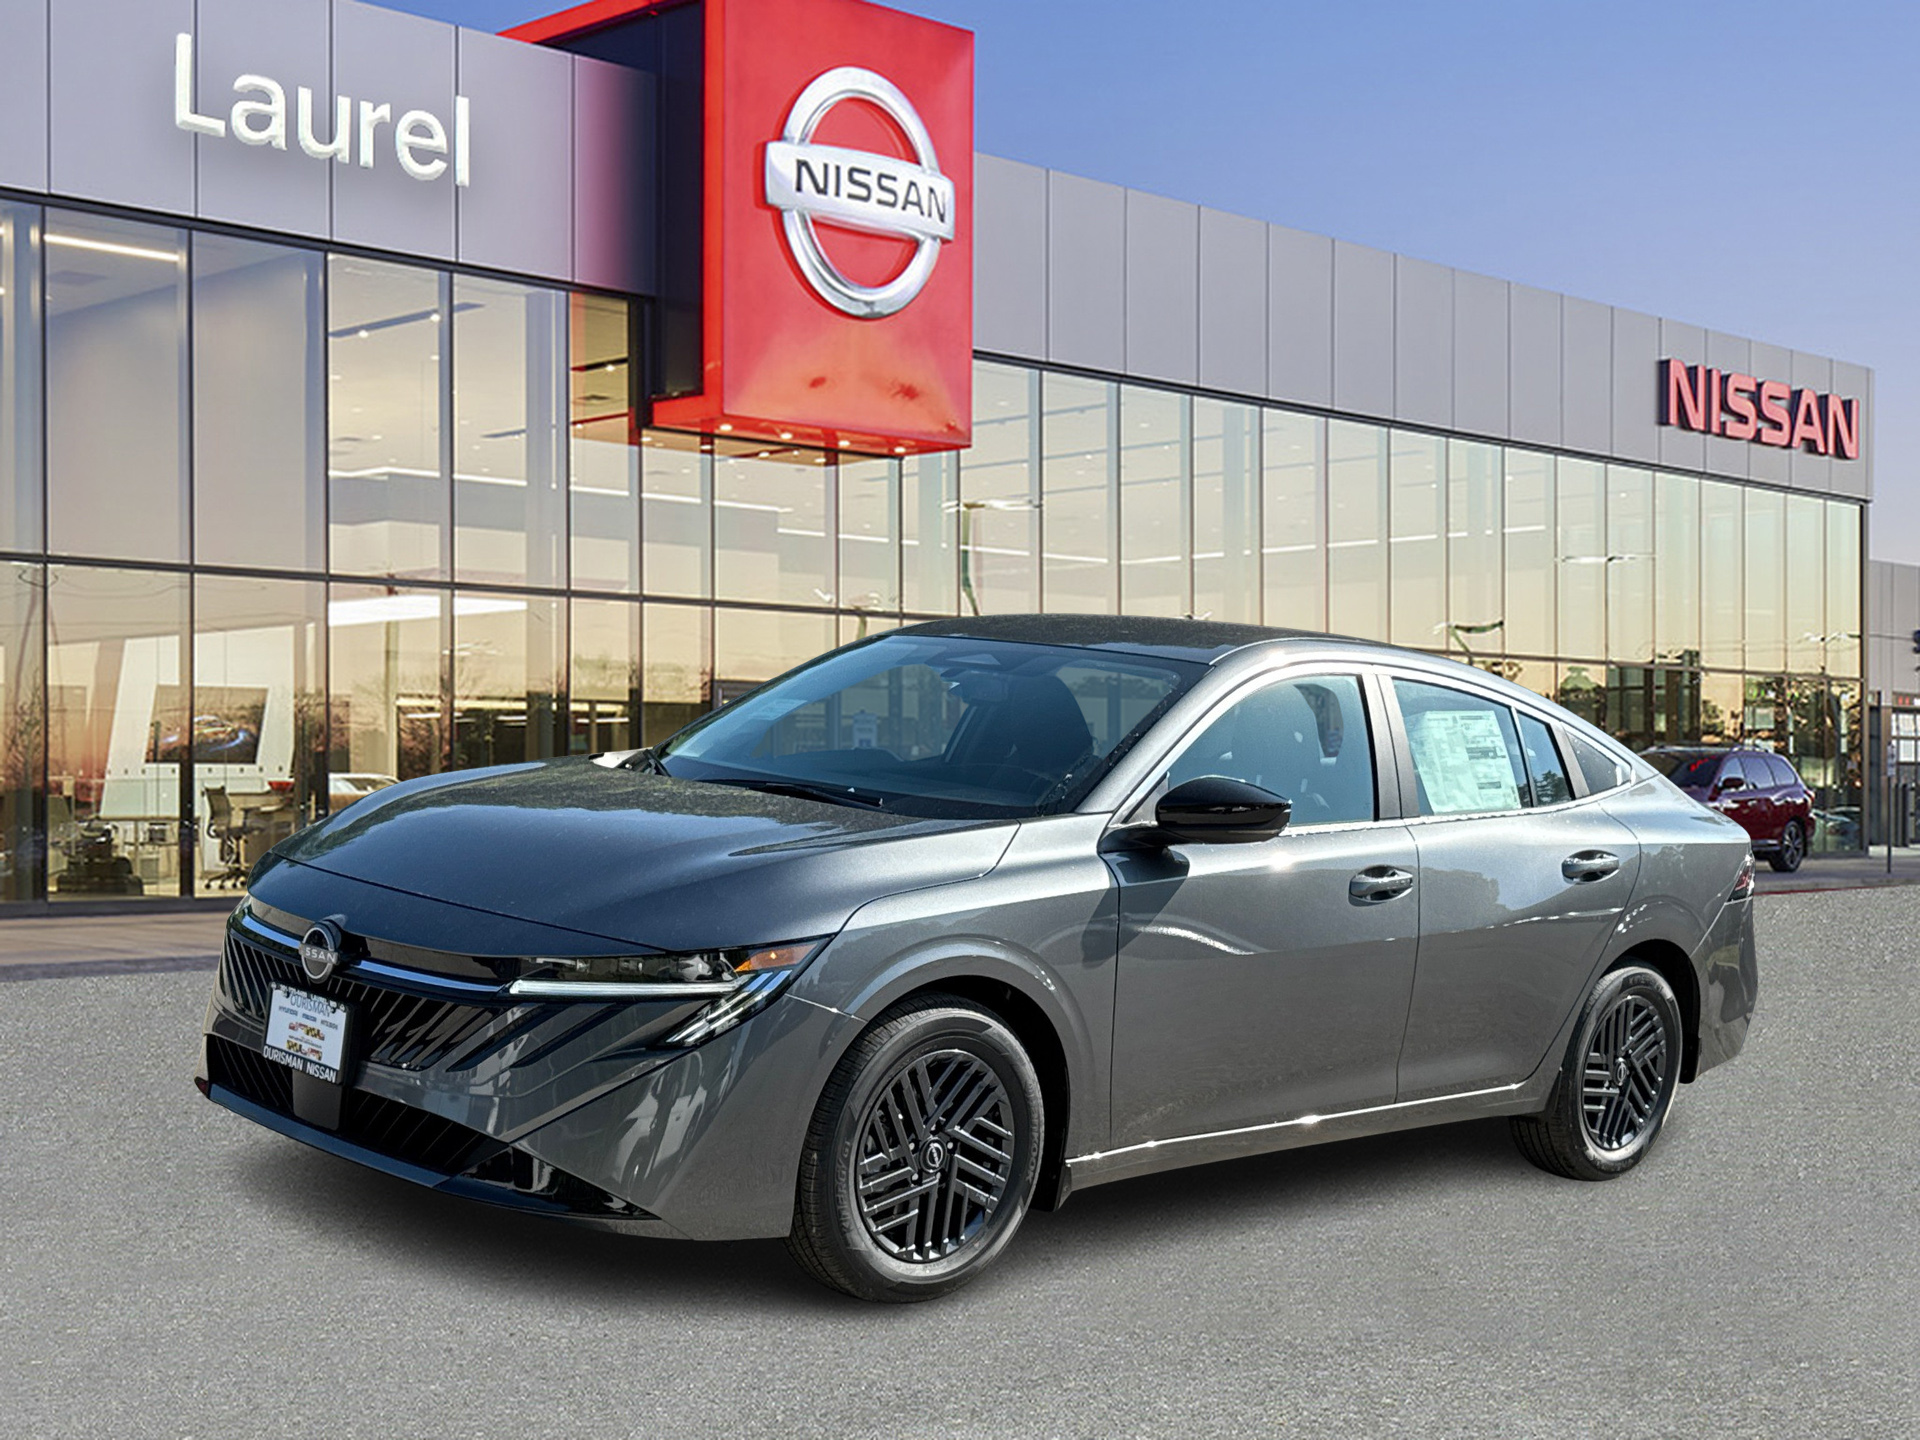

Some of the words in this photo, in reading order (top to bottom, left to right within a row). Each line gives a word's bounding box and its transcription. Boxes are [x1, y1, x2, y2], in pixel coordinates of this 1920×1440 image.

[175, 32, 469, 187] Laurel
[795, 158, 947, 223] NISSAN
[1662, 357, 1860, 460] NISSAN
[303, 947, 335, 963] SSAN
[263, 1045, 304, 1071] OURISMAN
[306, 1061, 336, 1083] NISSAN
